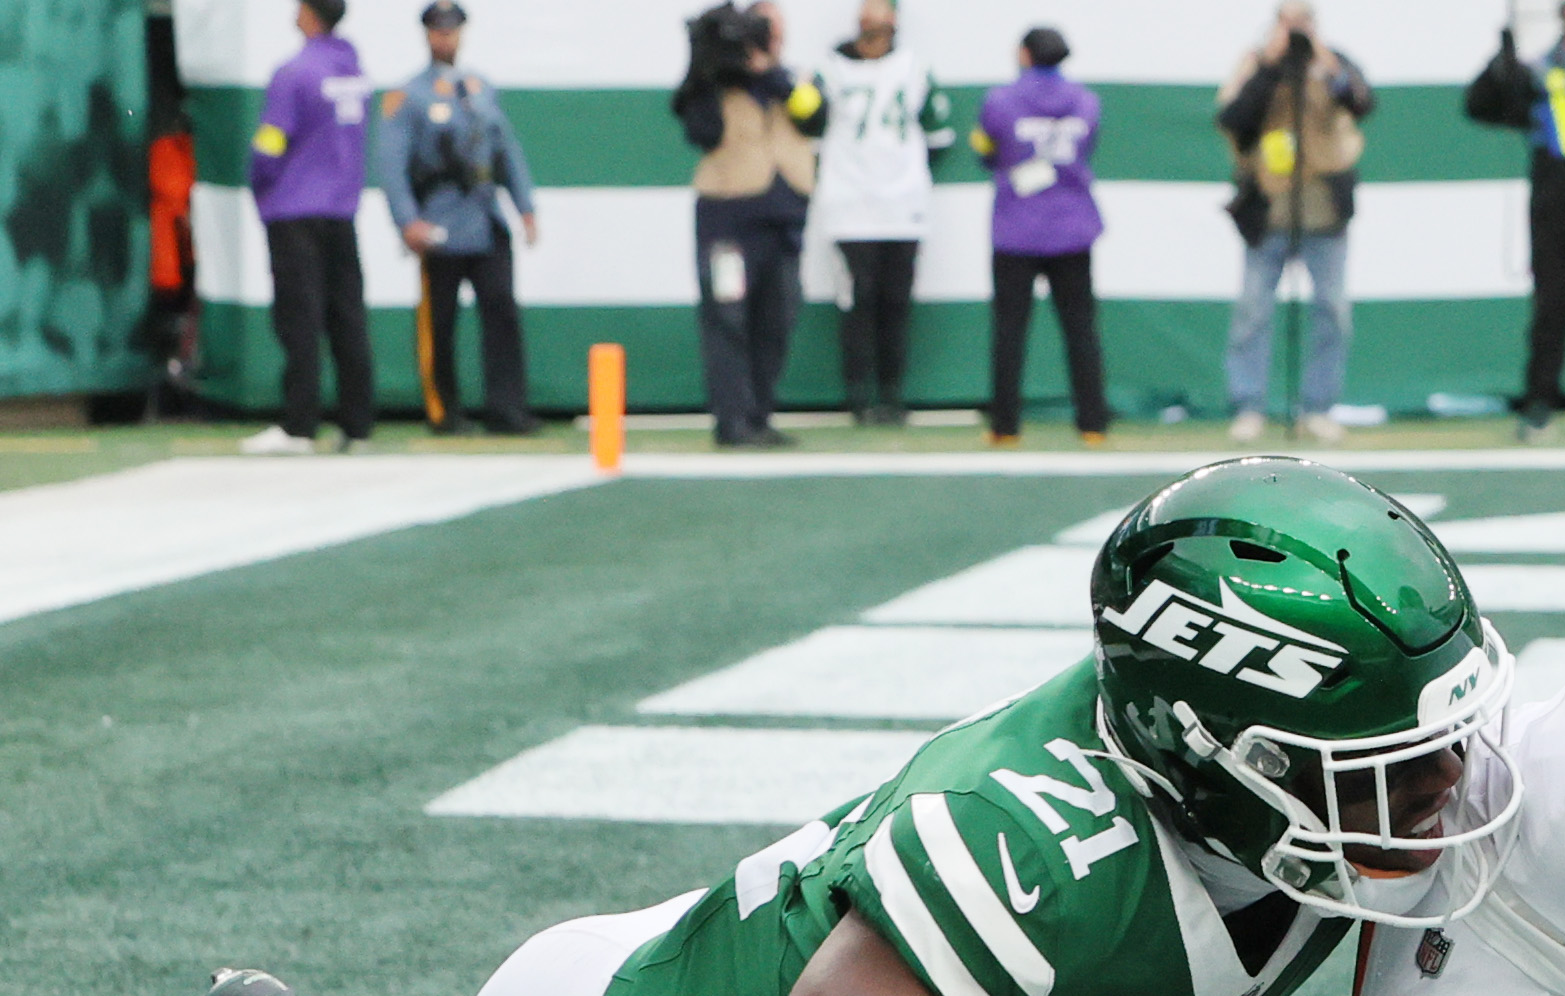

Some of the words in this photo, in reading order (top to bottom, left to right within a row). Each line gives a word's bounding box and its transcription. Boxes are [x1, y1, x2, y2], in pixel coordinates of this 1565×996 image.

[841, 84, 908, 142] 74
[1101, 576, 1349, 699] JETS
[1448, 664, 1481, 707] NY
[989, 737, 1140, 881] 21
